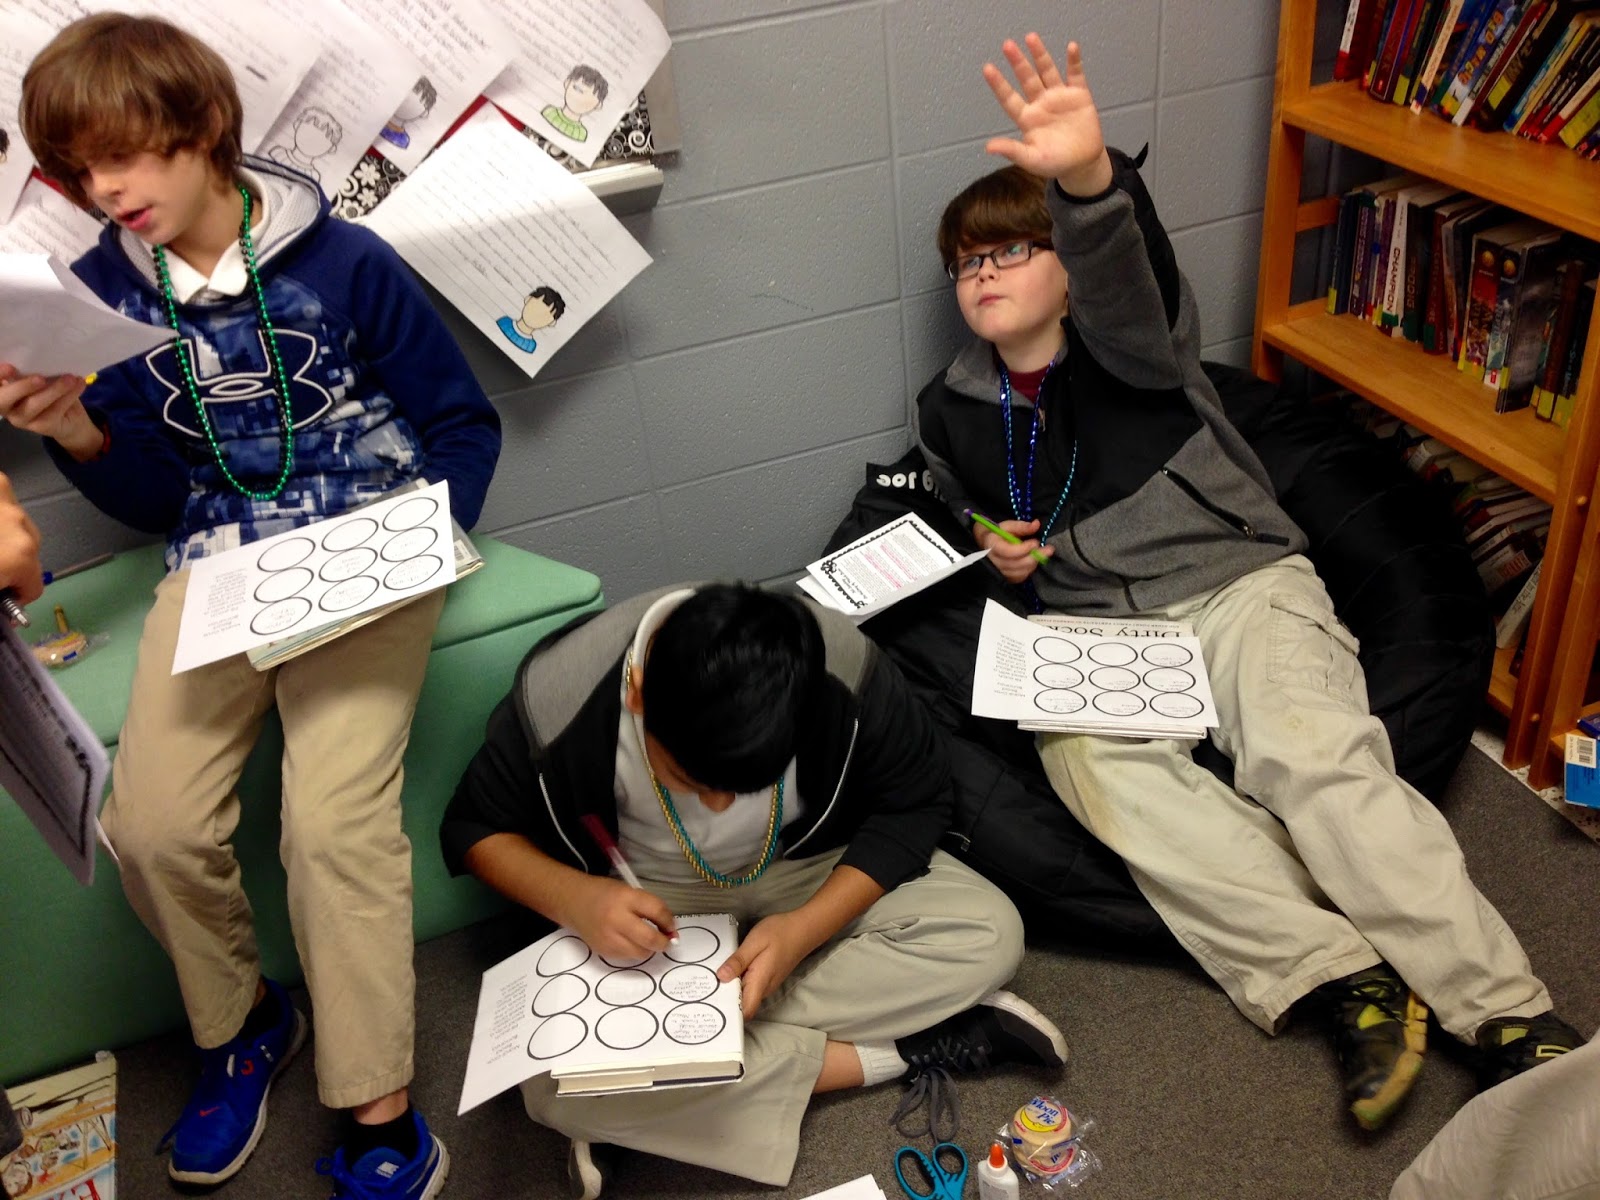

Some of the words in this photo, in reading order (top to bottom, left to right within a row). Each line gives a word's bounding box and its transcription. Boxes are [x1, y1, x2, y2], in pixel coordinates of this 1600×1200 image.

[1386, 247, 1401, 312] CHAMPION
[1030, 1096, 1059, 1117] Moon
[1037, 1112, 1055, 1125] Pie
